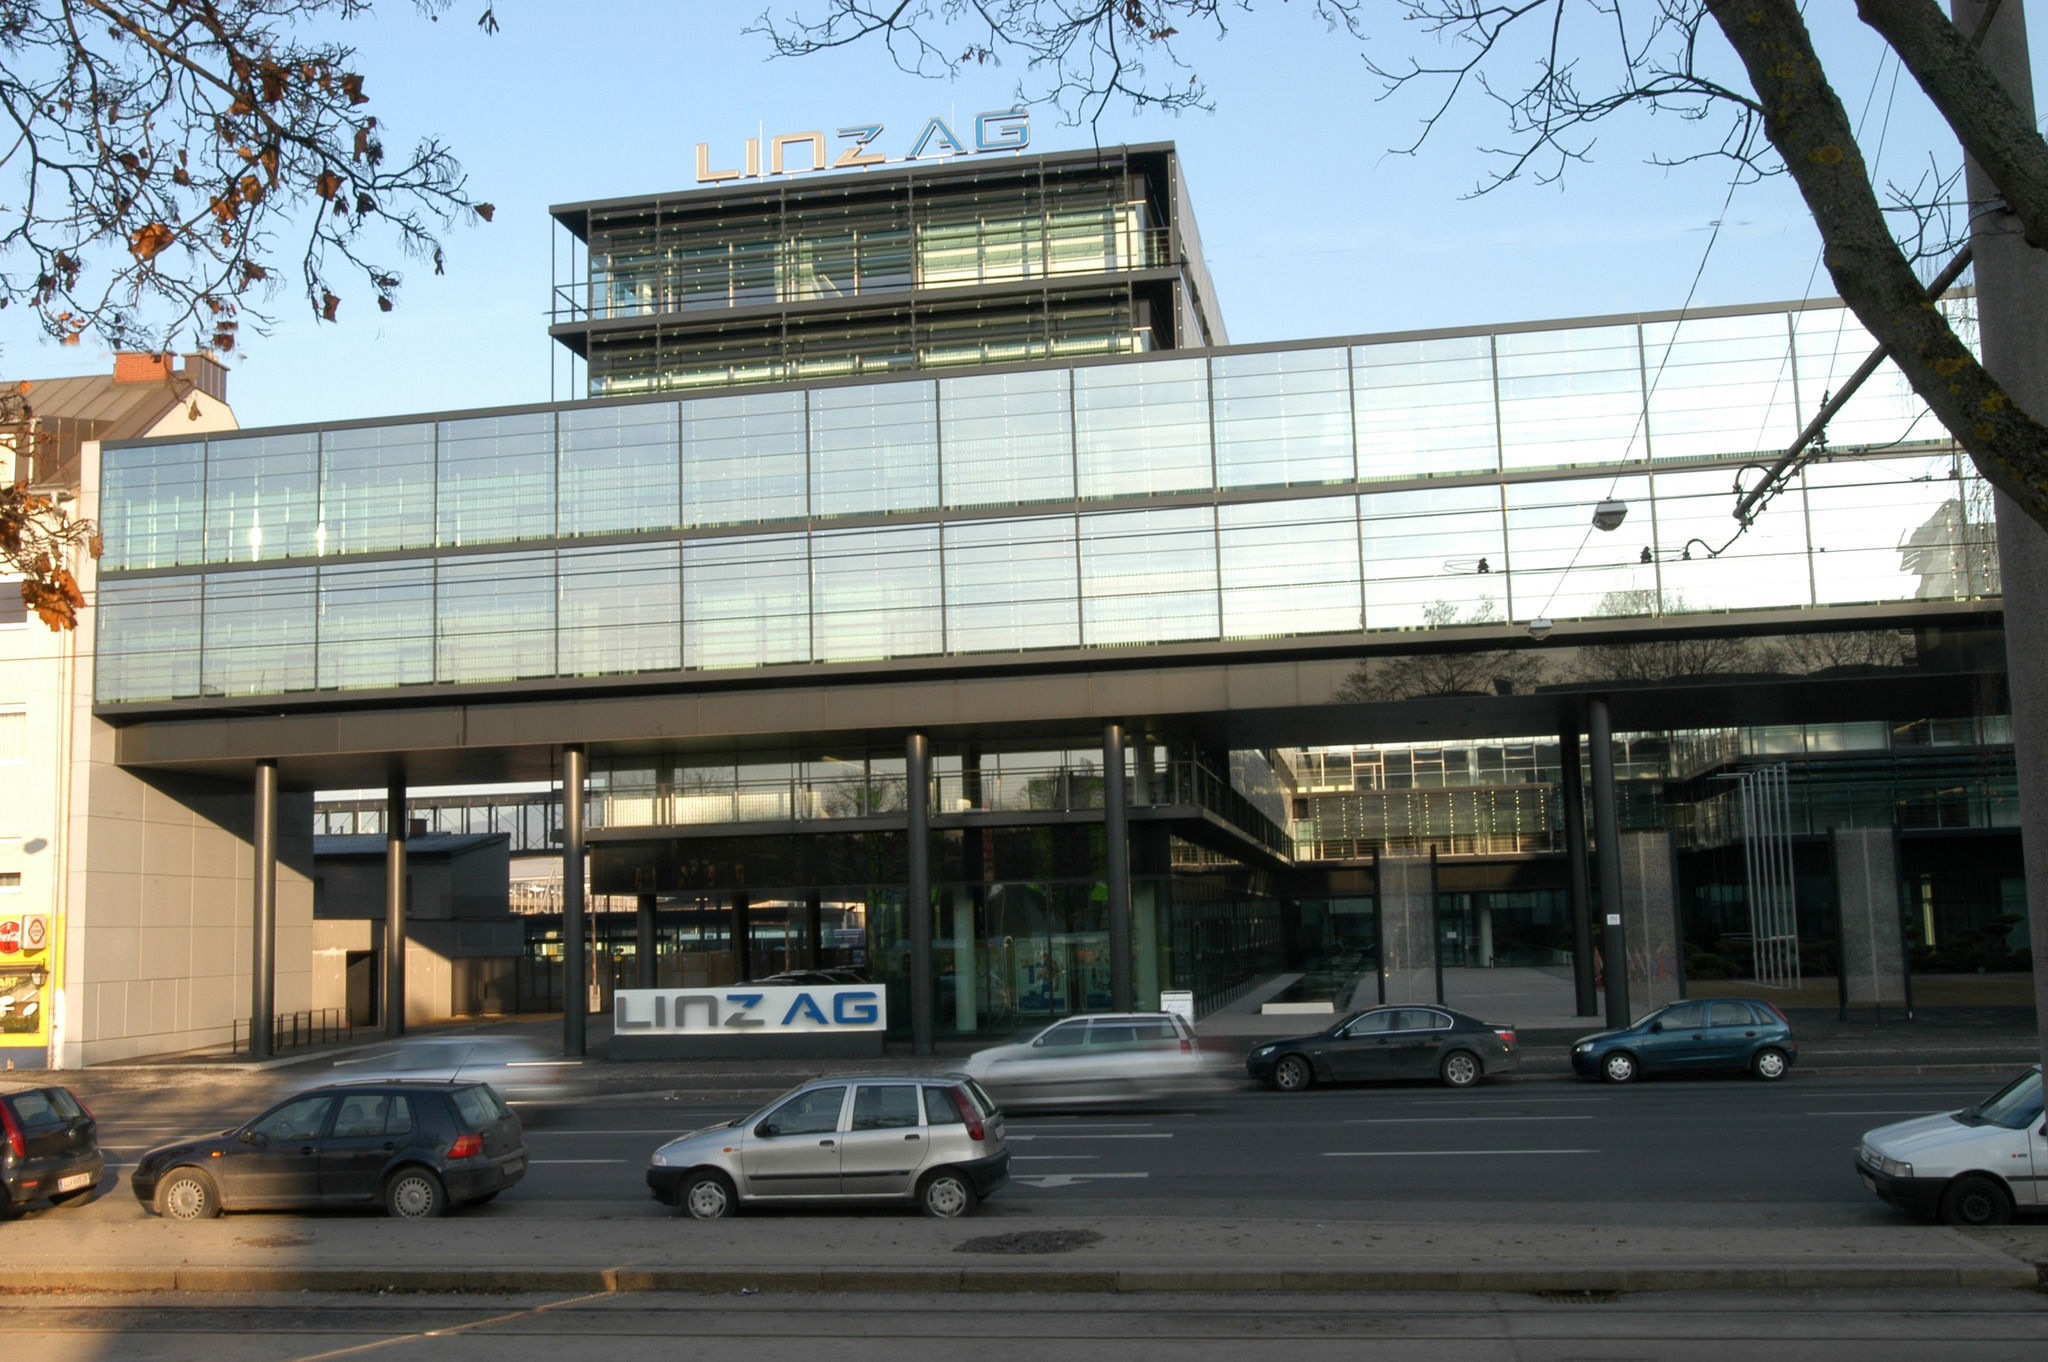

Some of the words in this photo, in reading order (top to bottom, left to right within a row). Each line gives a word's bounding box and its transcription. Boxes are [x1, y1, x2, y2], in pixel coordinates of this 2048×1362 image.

[695, 123, 885, 183] LINZ
[906, 109, 1030, 161] AG
[616, 994, 765, 1028] LINZ
[781, 992, 878, 1025] AG
